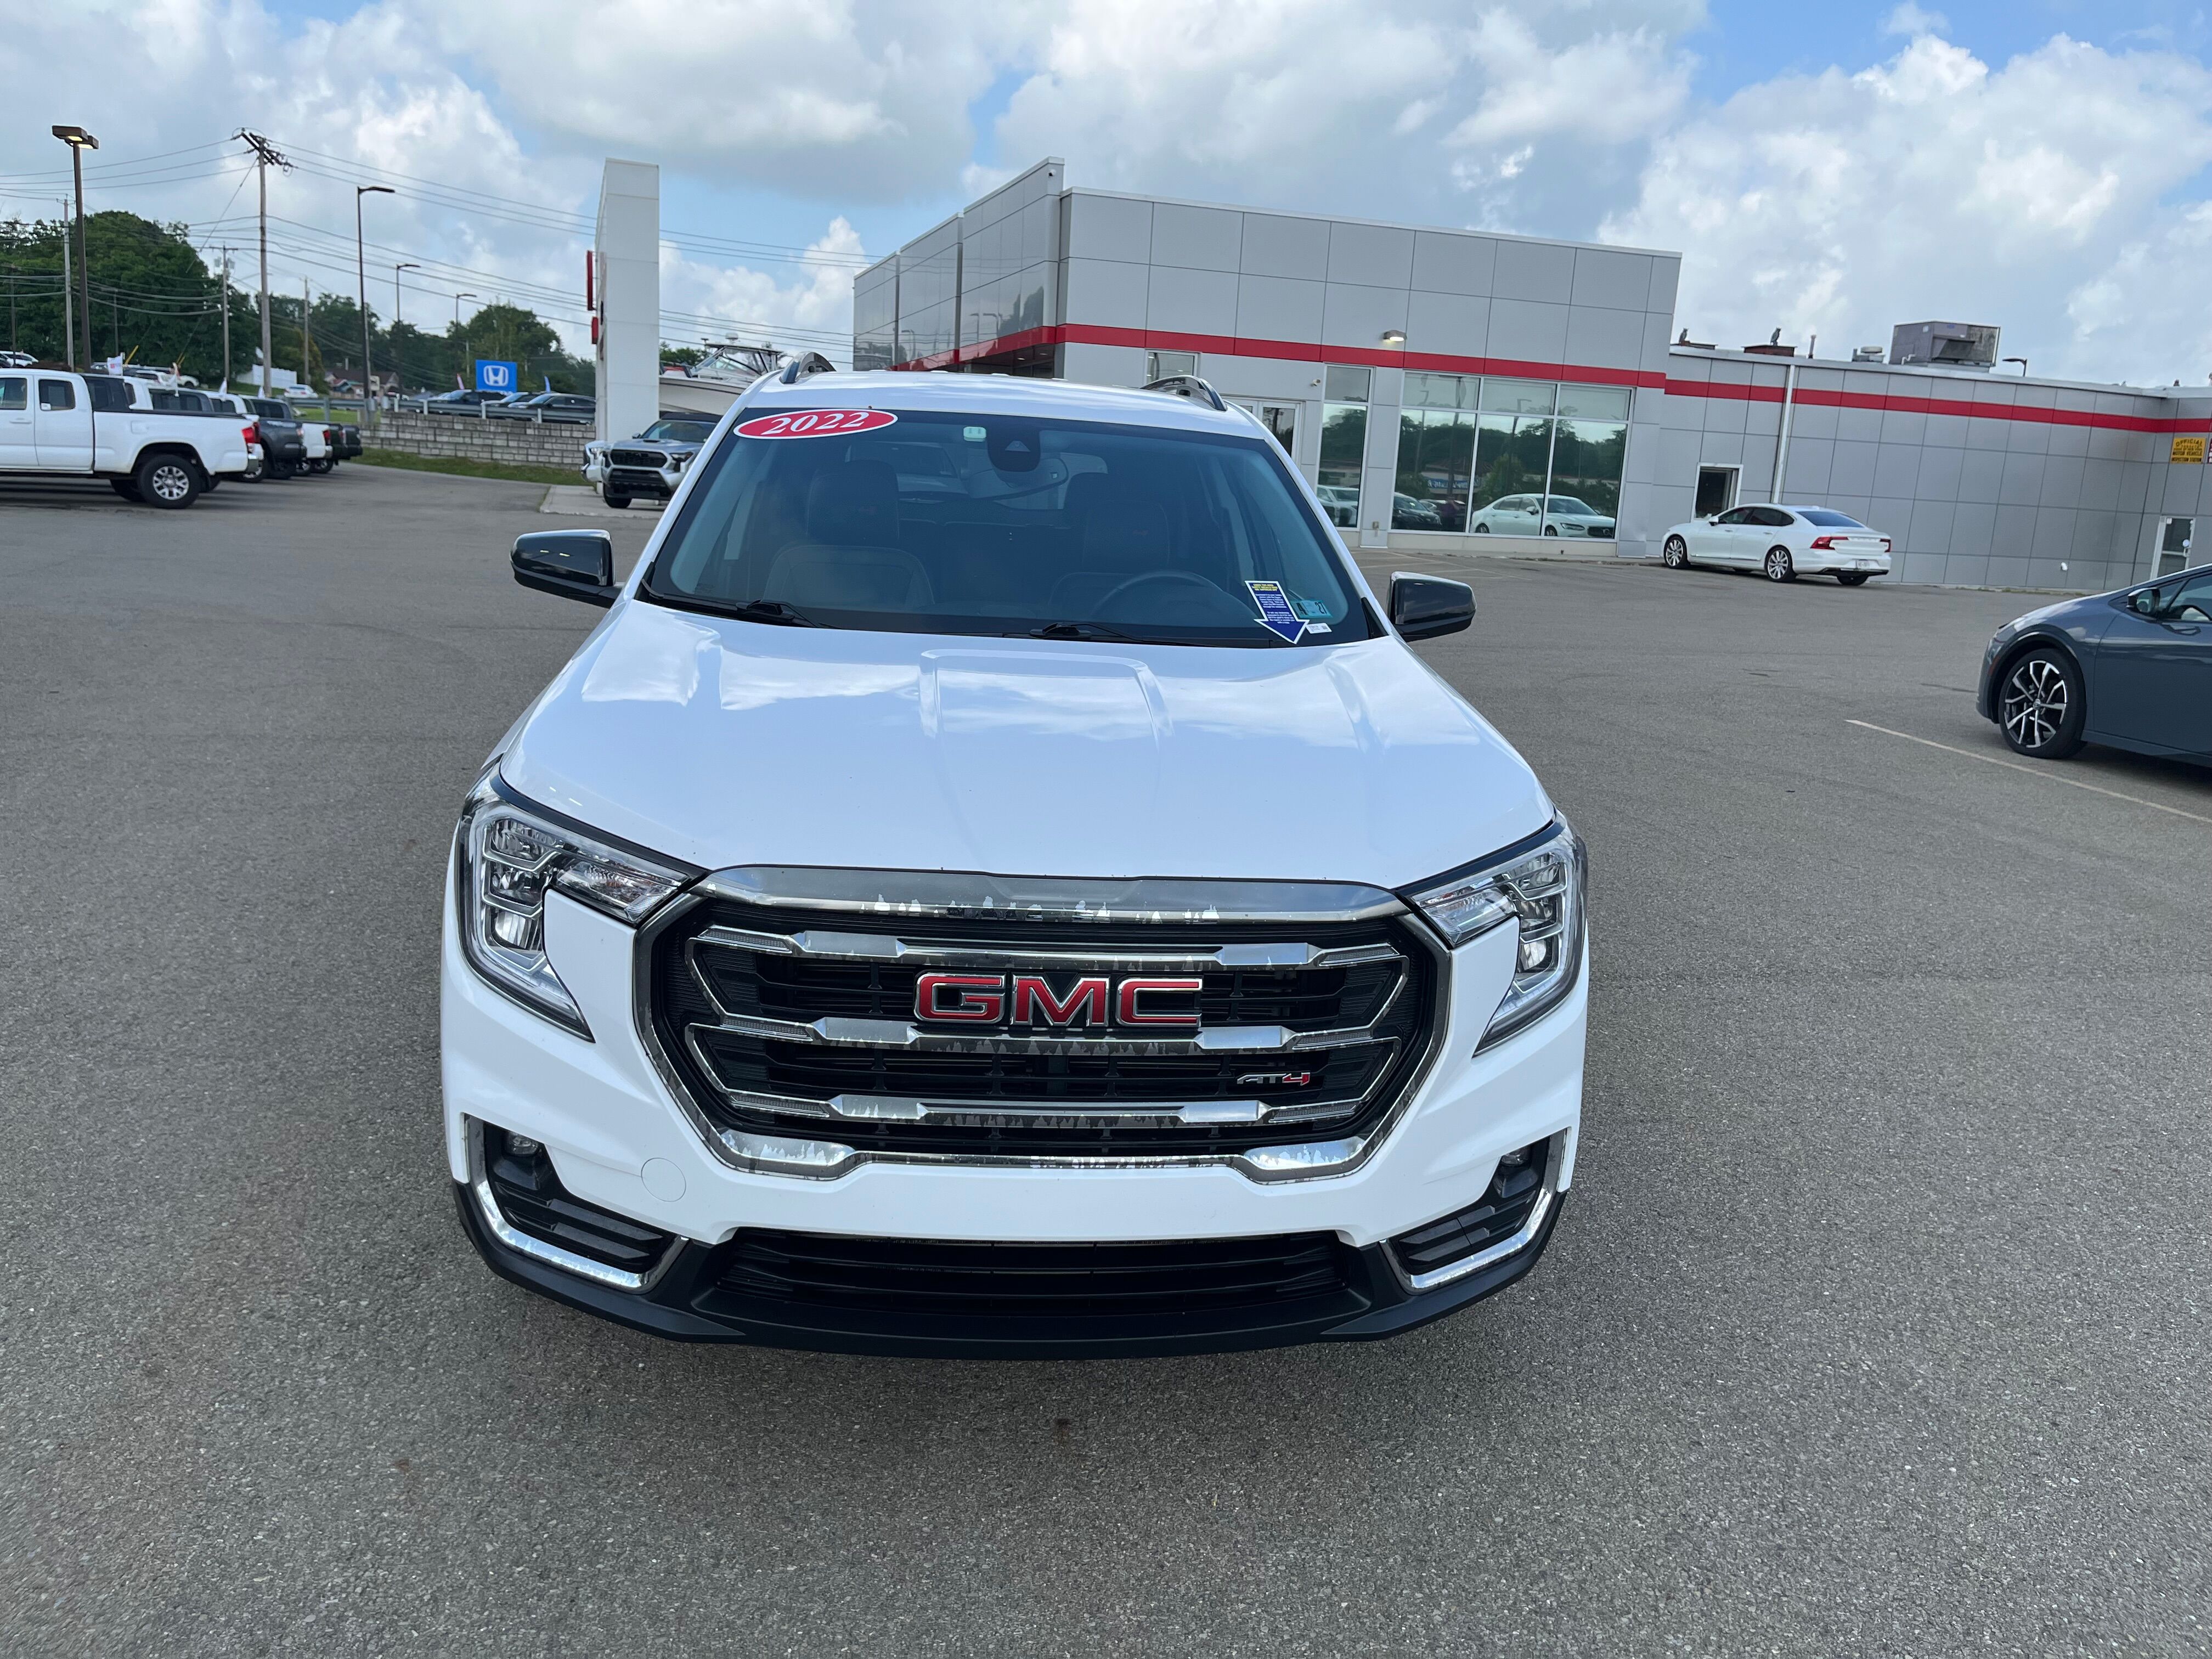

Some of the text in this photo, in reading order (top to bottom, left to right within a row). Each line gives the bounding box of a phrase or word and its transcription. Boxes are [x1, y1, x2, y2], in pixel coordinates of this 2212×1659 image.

[760, 412, 870, 435] 2022
[2175, 438, 2203, 447] OFFICIAL
[1314, 602, 1327, 614] 27
[913, 972, 1203, 1027] GMC
[1237, 1072, 1311, 1086] AT4
